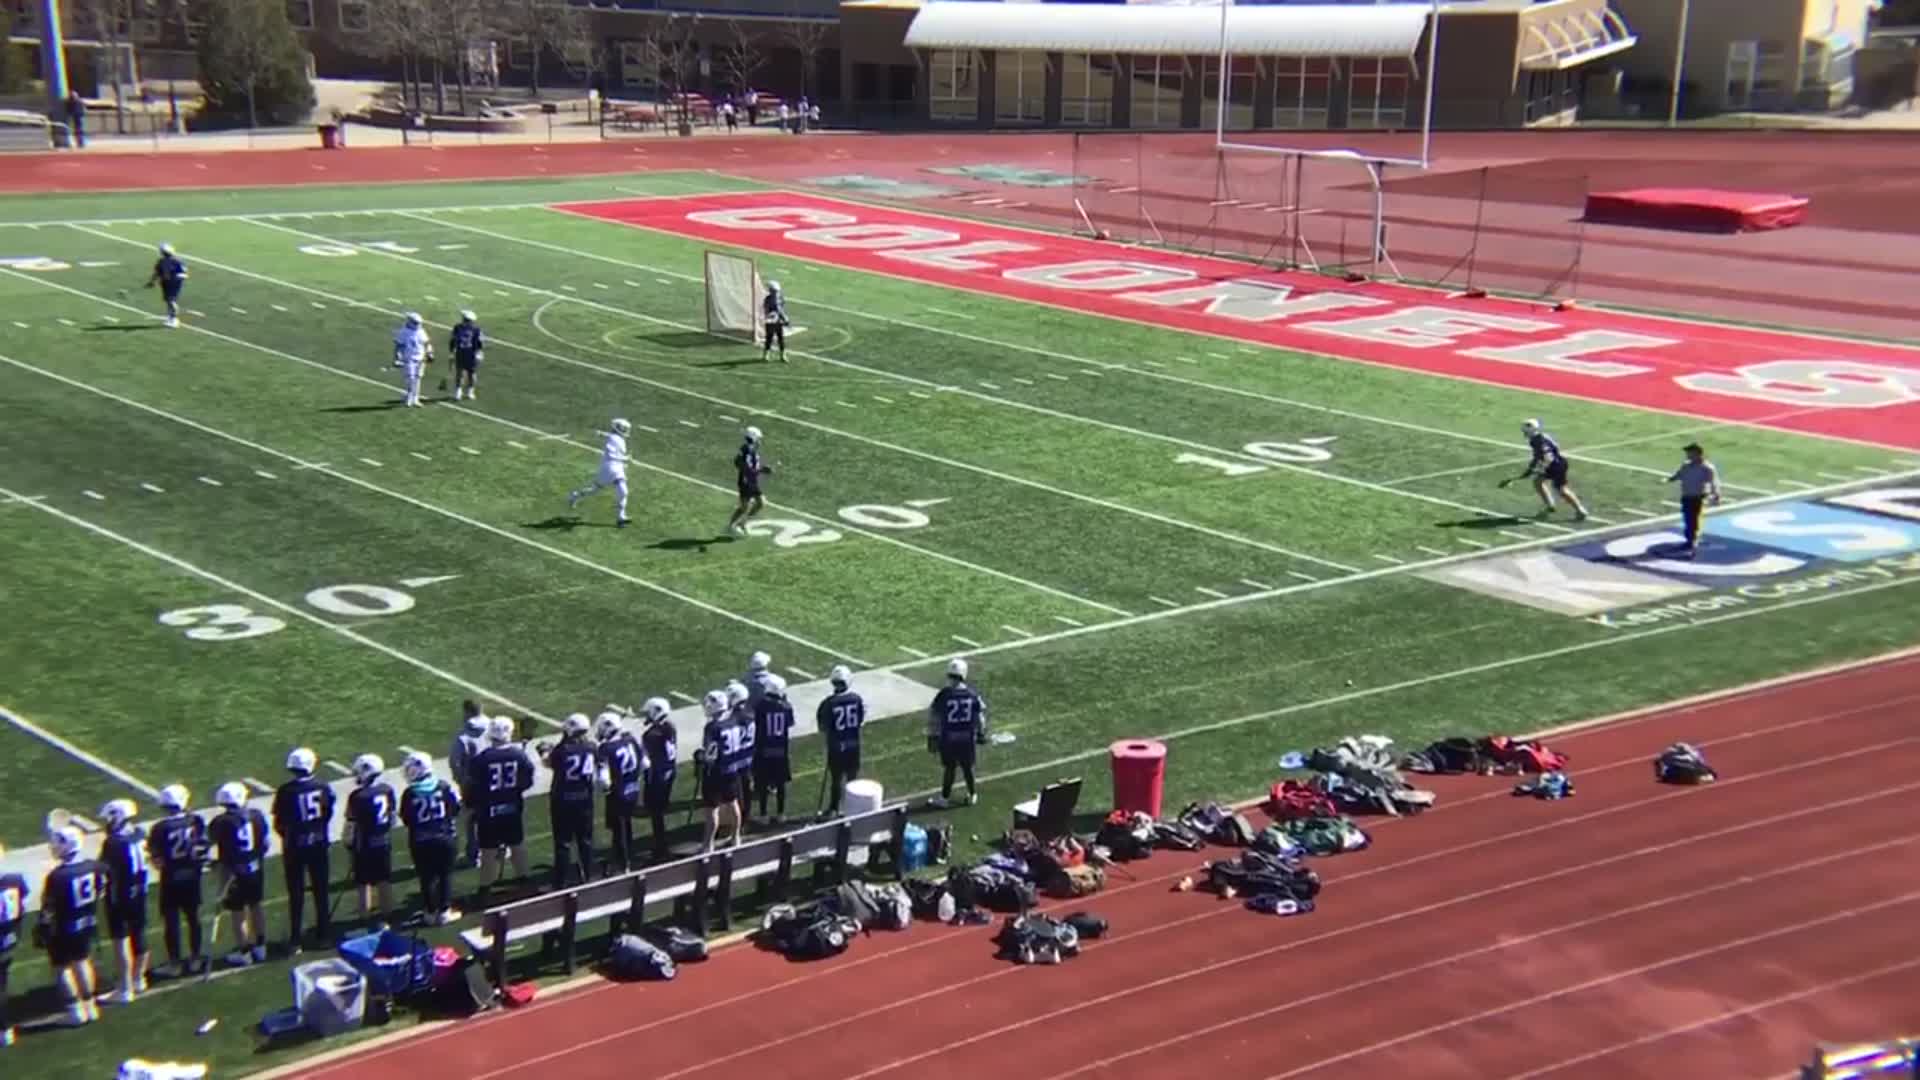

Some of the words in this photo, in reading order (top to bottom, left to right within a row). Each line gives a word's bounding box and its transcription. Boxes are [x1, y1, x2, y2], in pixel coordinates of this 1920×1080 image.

[685, 206, 1920, 408] COLONELS
[1172, 441, 1333, 476] 10
[744, 504, 930, 548] 20
[158, 584, 416, 640] 30
[765, 711, 785, 737] 10
[946, 698, 973, 723] 23
[488, 760, 518, 792] 33
[565, 752, 595, 782] 24
[298, 789, 322, 823] 15
[413, 789, 446, 823] 25
[236, 821, 255, 852] 9
